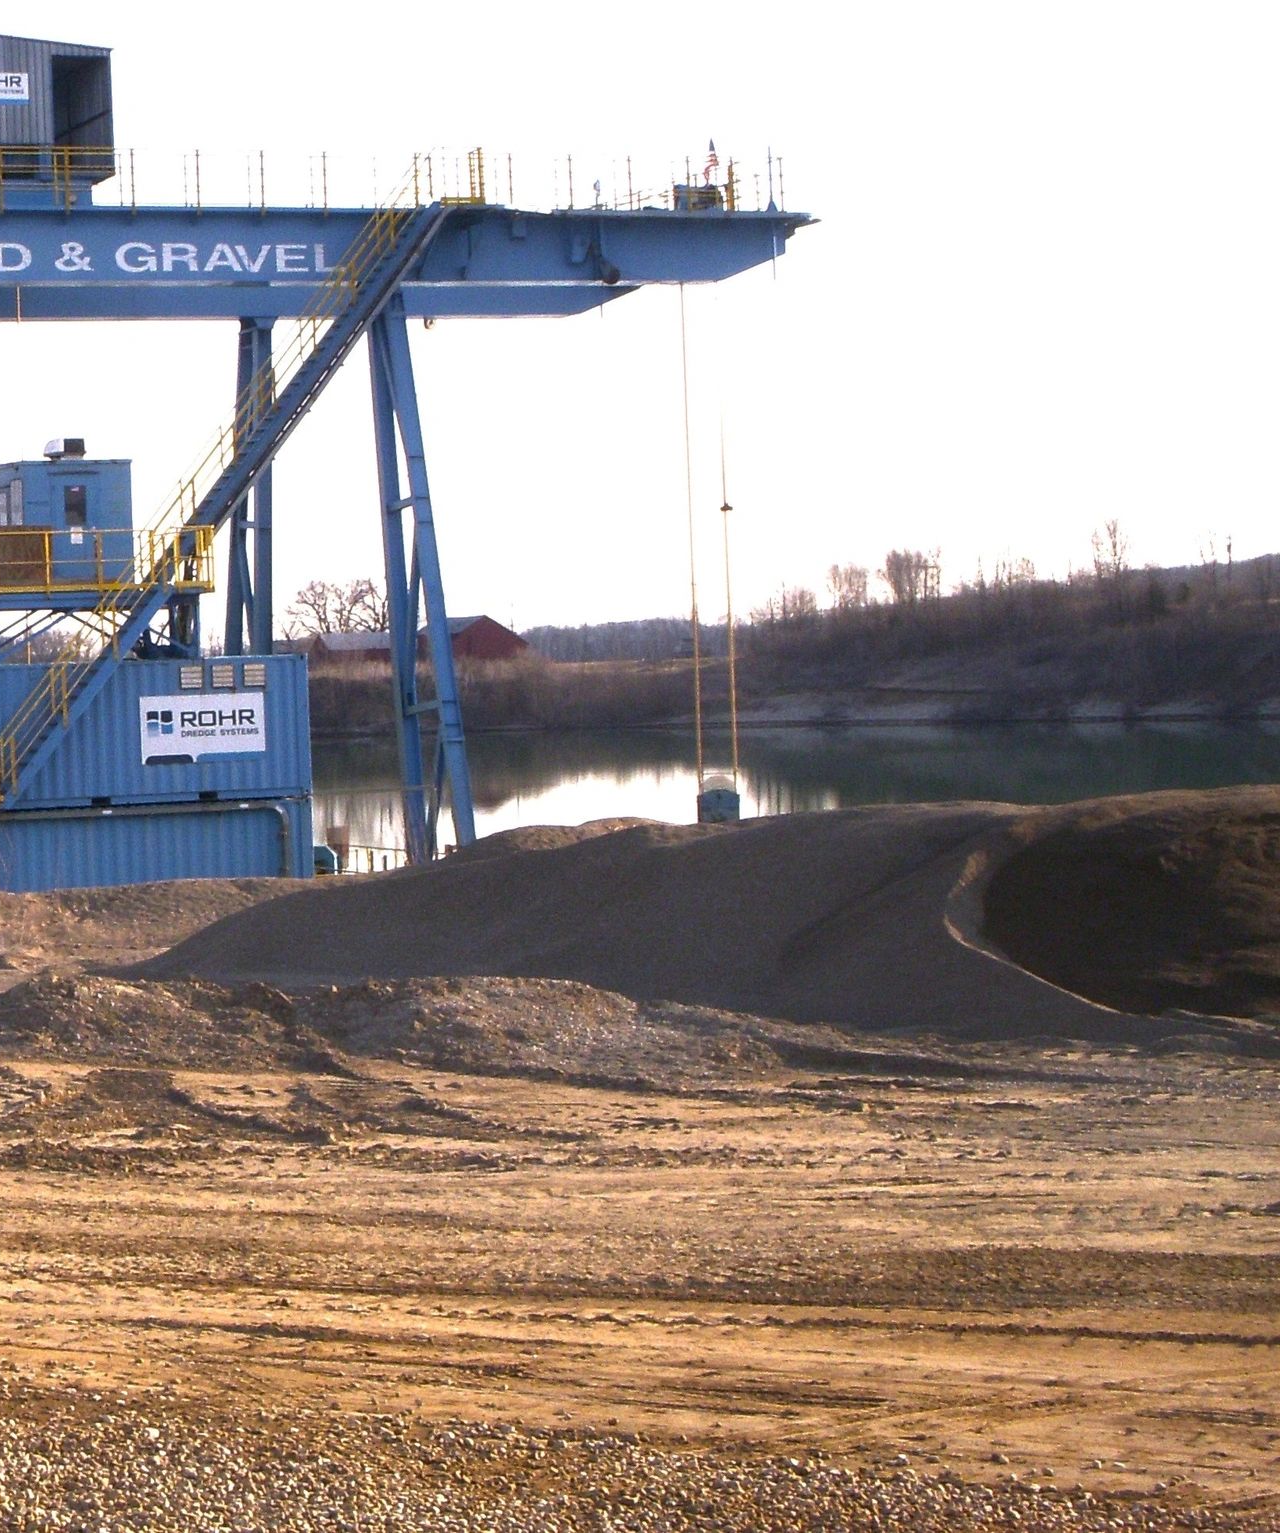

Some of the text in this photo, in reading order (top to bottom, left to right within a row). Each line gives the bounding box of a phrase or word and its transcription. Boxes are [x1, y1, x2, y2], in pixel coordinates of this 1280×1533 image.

[54, 242, 94, 272] &
[115, 242, 350, 273] GRAVEL
[180, 709, 255, 727] ROHR
